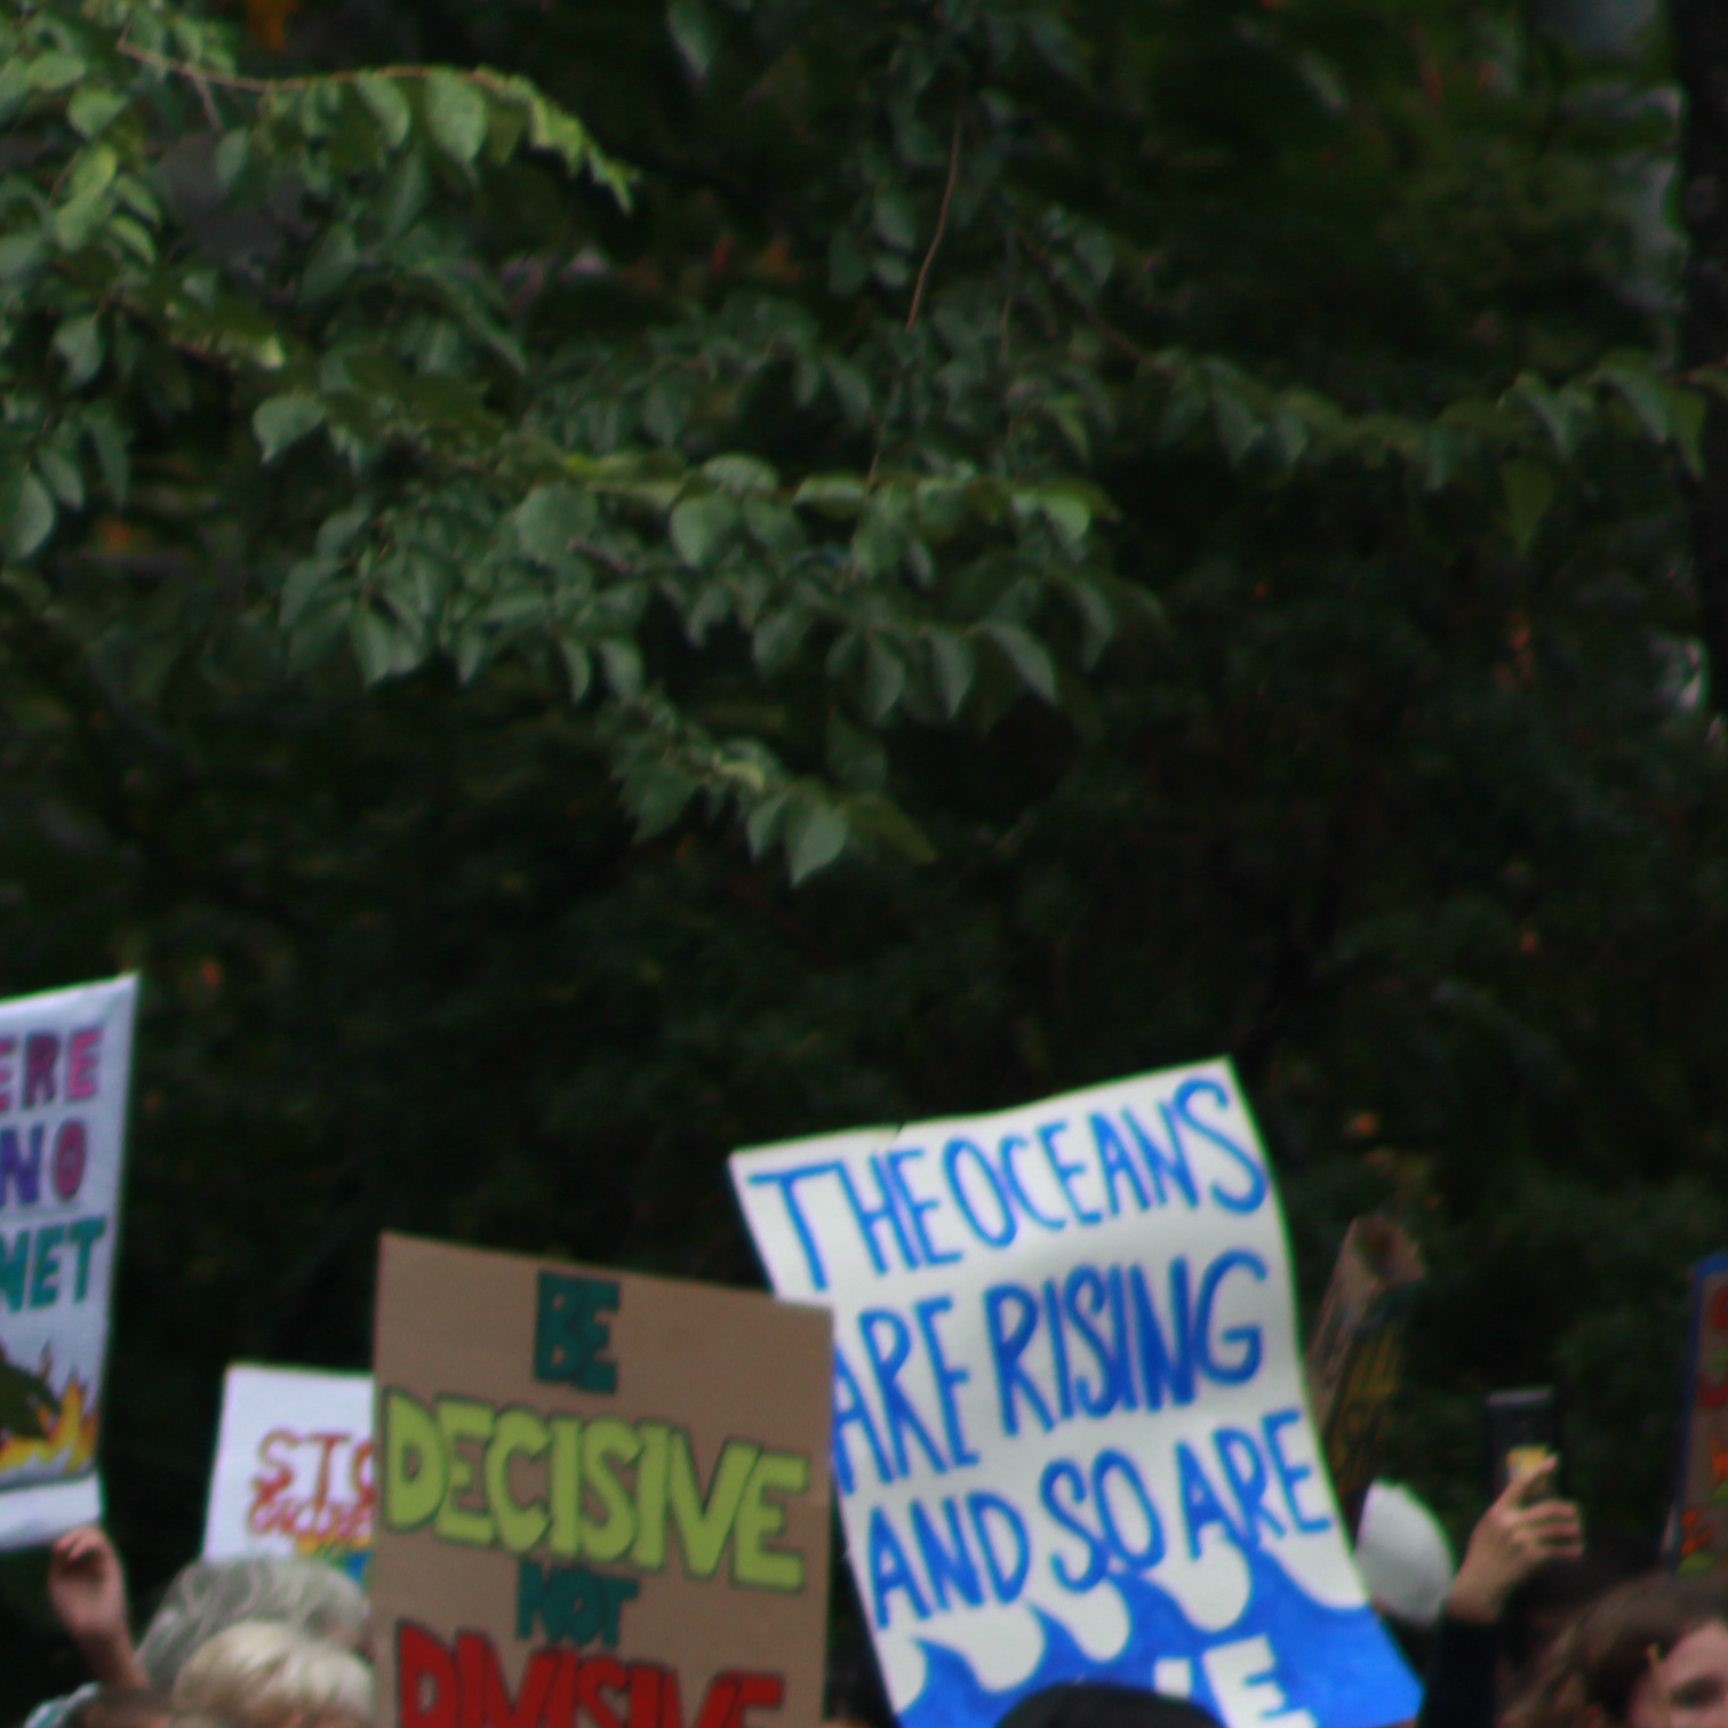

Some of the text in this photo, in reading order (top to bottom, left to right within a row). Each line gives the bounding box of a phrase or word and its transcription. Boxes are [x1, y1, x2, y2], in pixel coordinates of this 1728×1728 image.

[747, 1075, 1271, 1292] THE OCEANS
[534, 1267, 620, 1394] BE
[831, 1295, 981, 1496] ARE
[982, 1248, 1268, 1438] RISING
[383, 1386, 811, 1596] DECISIVE
[867, 1489, 1032, 1630] AND
[1039, 1447, 1166, 1596] SO
[1174, 1408, 1333, 1562] ARE
[516, 1554, 641, 1648] NOT
